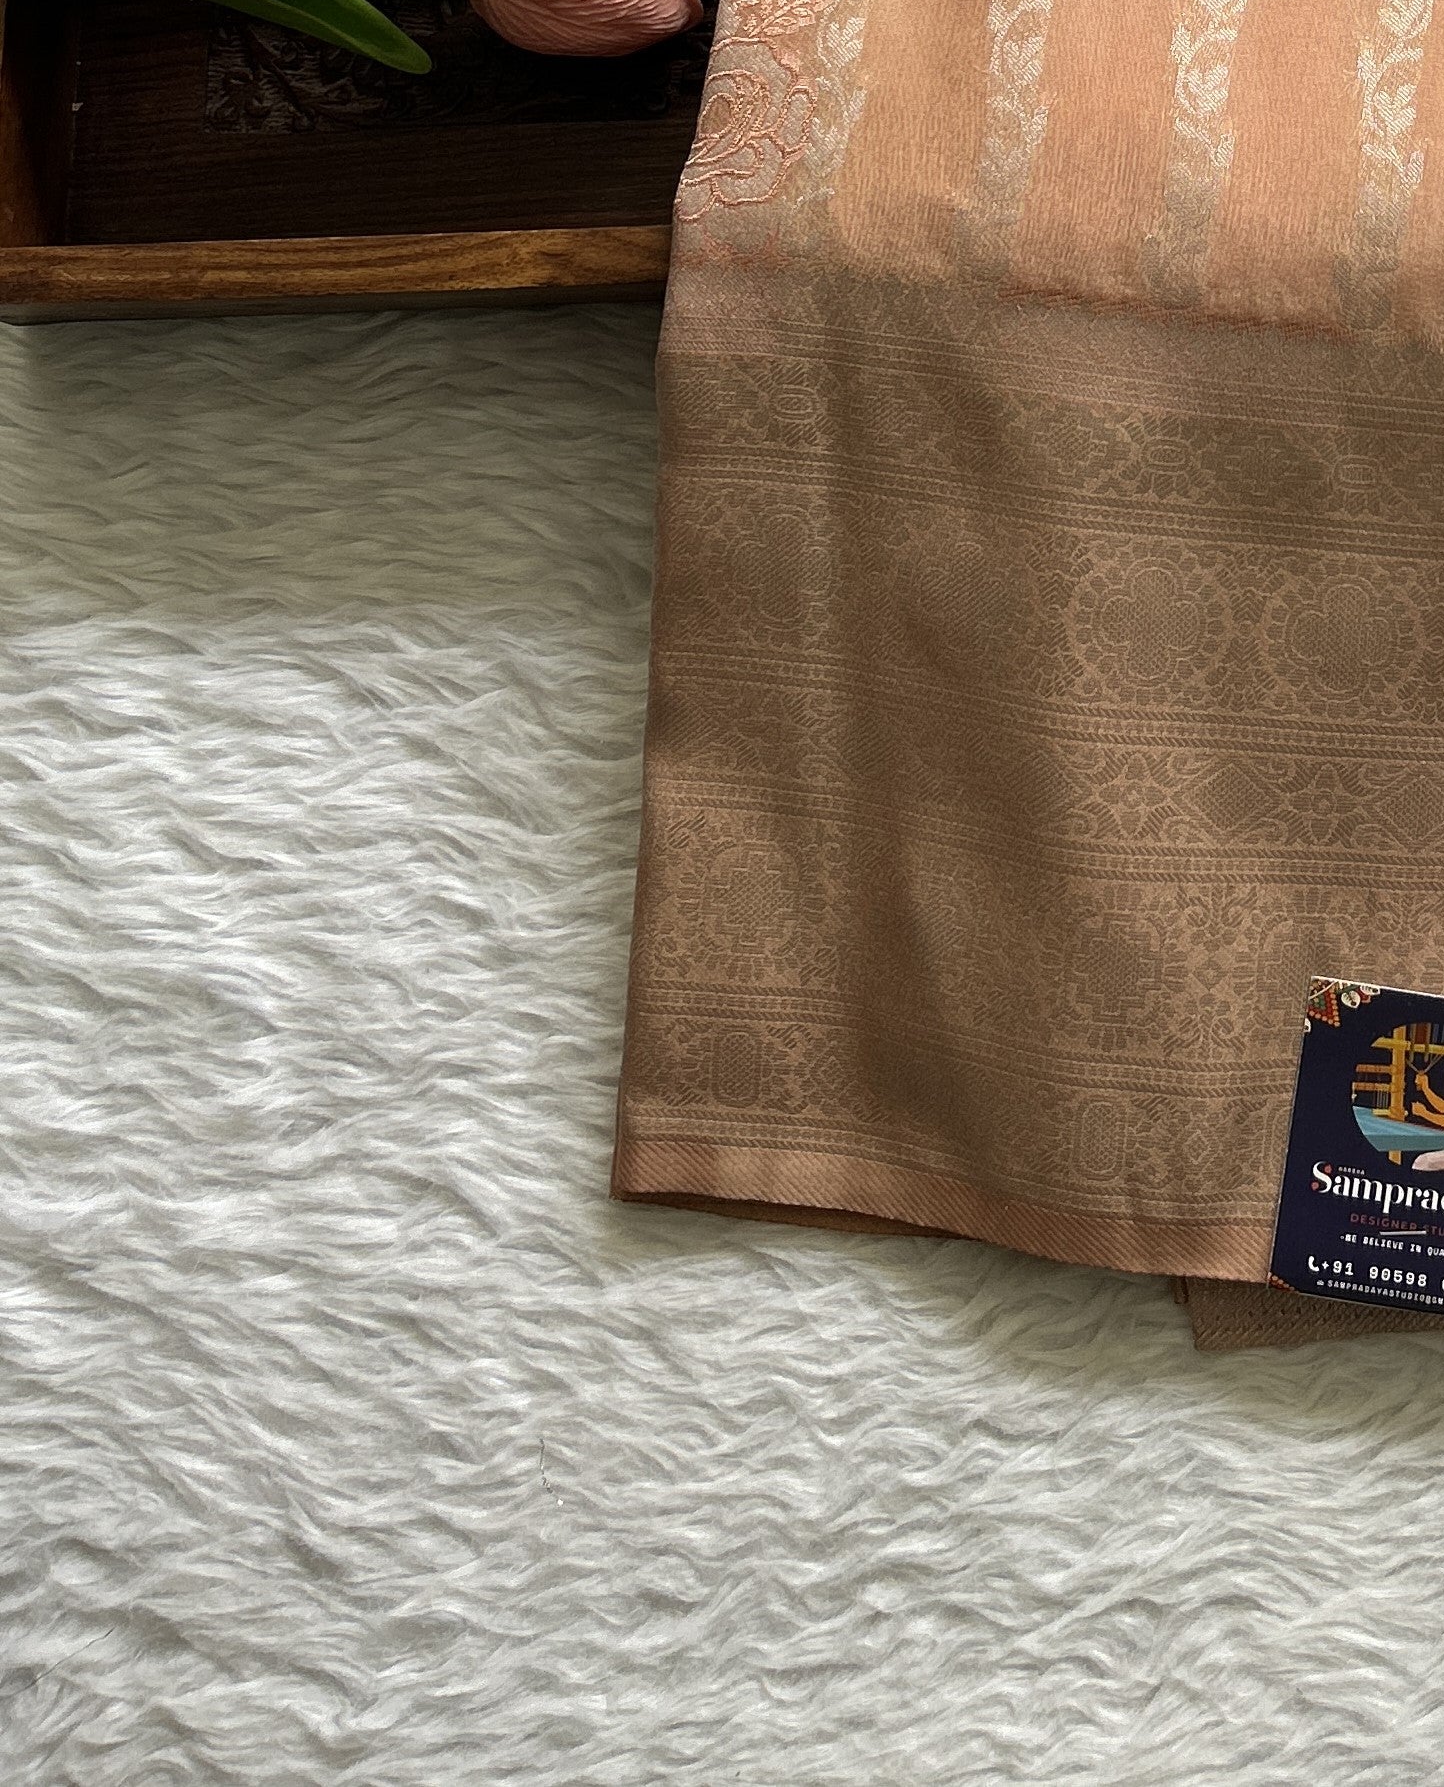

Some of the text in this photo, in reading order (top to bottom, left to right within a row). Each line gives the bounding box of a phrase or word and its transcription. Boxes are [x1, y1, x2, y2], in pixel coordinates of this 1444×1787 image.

[1350, 1213, 1417, 1230] DESIGNER
[1363, 1236, 1404, 1250] BELIEVE
[1410, 1243, 1422, 1253] IN
[1322, 1260, 1354, 1276] +91
[1369, 1266, 1427, 1287] 90598
